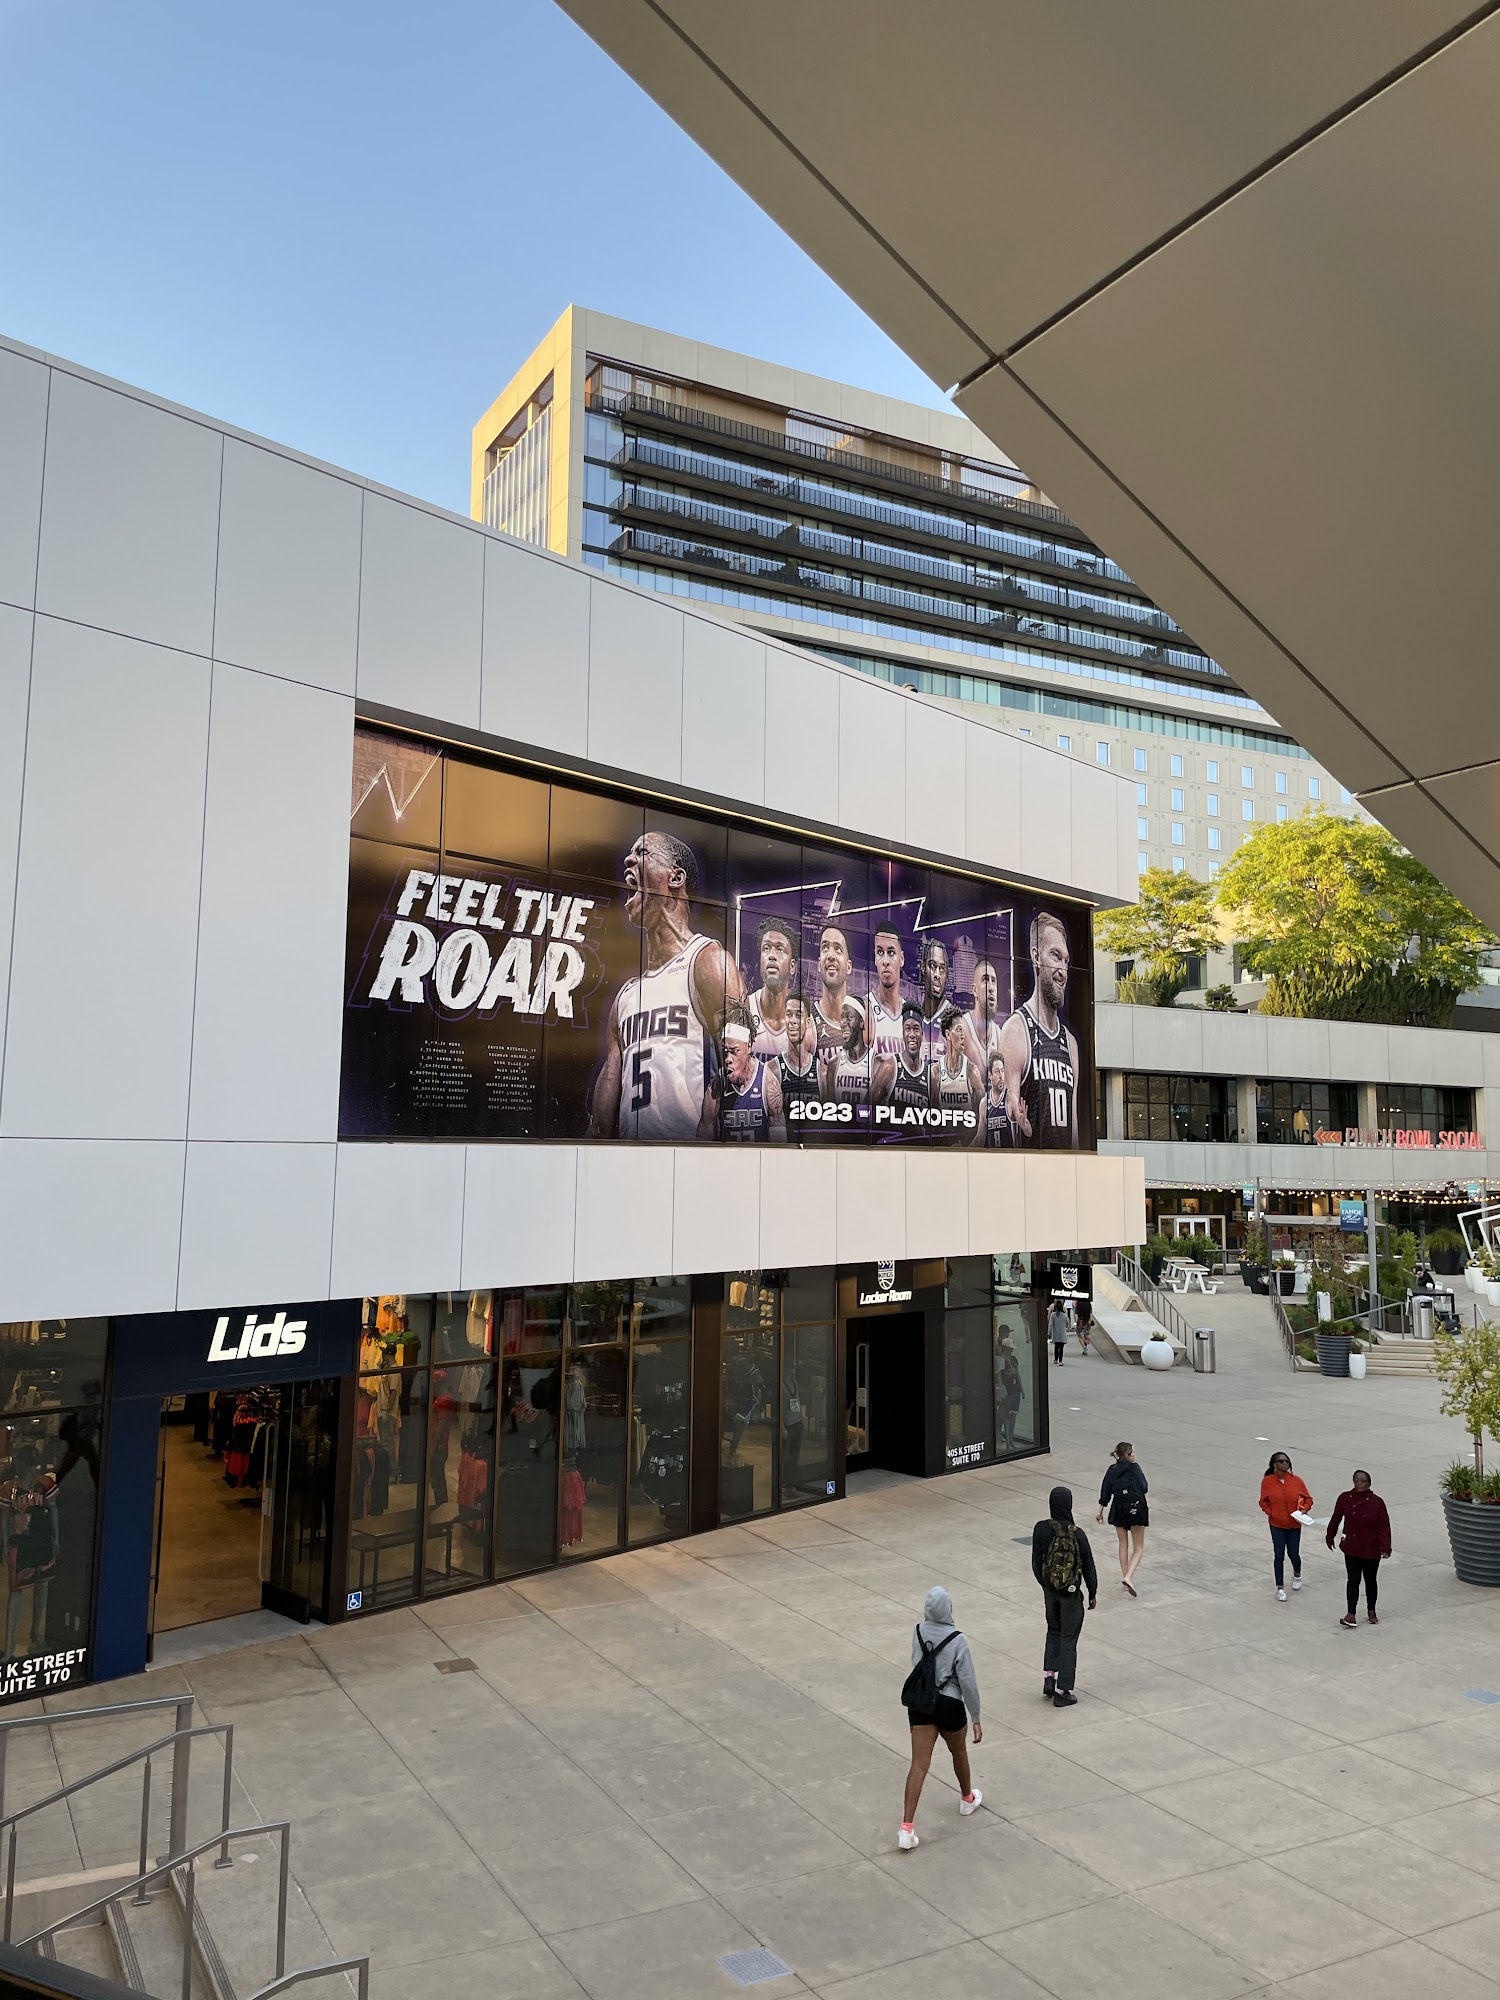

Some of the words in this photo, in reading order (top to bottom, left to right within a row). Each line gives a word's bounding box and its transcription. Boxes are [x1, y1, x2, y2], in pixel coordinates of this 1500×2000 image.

[397, 869, 505, 930] FEEL
[513, 887, 595, 943] THE
[368, 920, 585, 1019] ROAR
[631, 1048, 653, 1112] 5
[836, 1075, 869, 1089] KINGS
[1033, 1058, 1073, 1088] KINGS
[941, 1092, 969, 1104] KINGS
[1049, 1088, 1068, 1127] 10
[723, 1109, 763, 1128] SAC
[789, 1100, 853, 1122] 2023
[875, 1105, 977, 1128] PLAYOFFS
[988, 1116, 1007, 1130] SAC
[1345, 1127, 1395, 1147] PUNCH
[1396, 1129, 1435, 1149] BOWL
[1438, 1131, 1486, 1150] SOCIAL
[860, 1291, 889, 1305] Locker
[888, 1290, 913, 1302] Room
[207, 1312, 308, 1362] Lids
[947, 1448, 958, 1457] 405
[959, 1446, 963, 1456] K
[963, 1442, 985, 1454] STREET
[952, 1454, 969, 1466] SUITE
[971, 1452, 980, 1461] 170
[6, 1662, 18, 1678] K
[22, 1648, 87, 1674] STREET
[43, 1667, 71, 1685] 170
